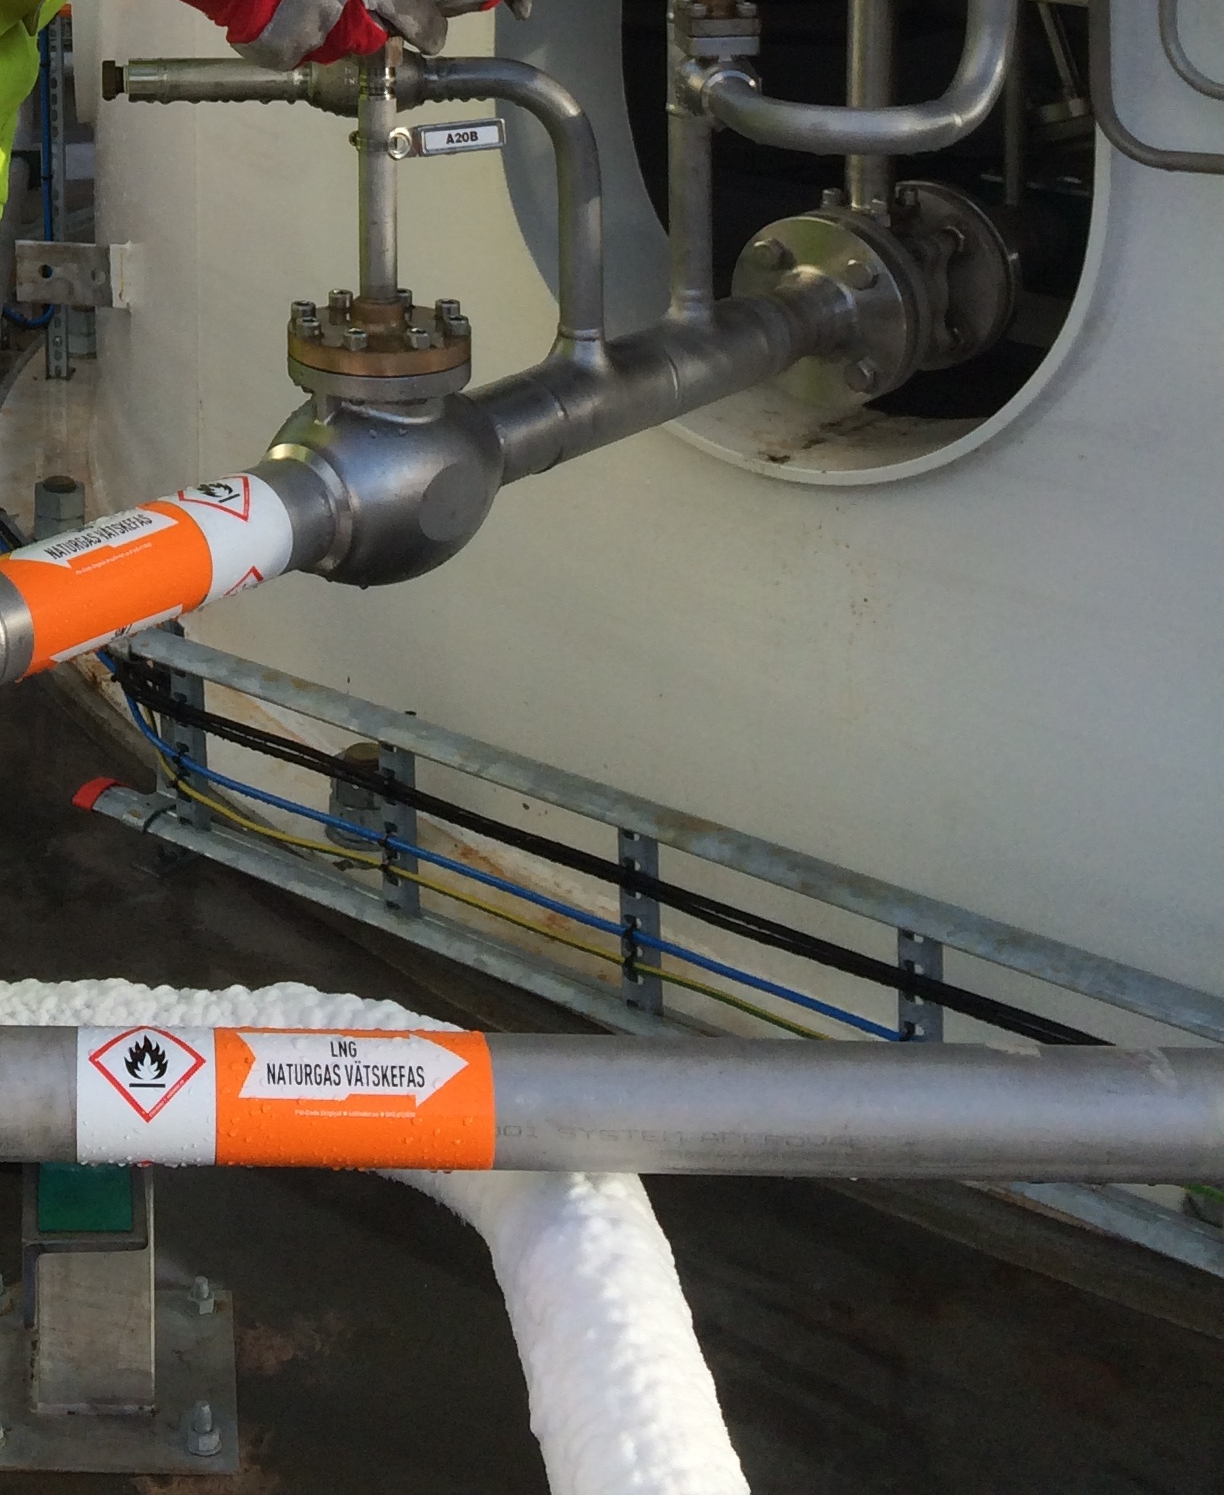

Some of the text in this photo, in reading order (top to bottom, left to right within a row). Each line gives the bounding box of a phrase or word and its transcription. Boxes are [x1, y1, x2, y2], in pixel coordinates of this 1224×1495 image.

[445, 131, 479, 145] A20B
[43, 532, 102, 560] NATURGAS
[330, 1040, 358, 1058] LNG
[266, 1060, 426, 1088] NATURGAS VÄTSKEFAS
